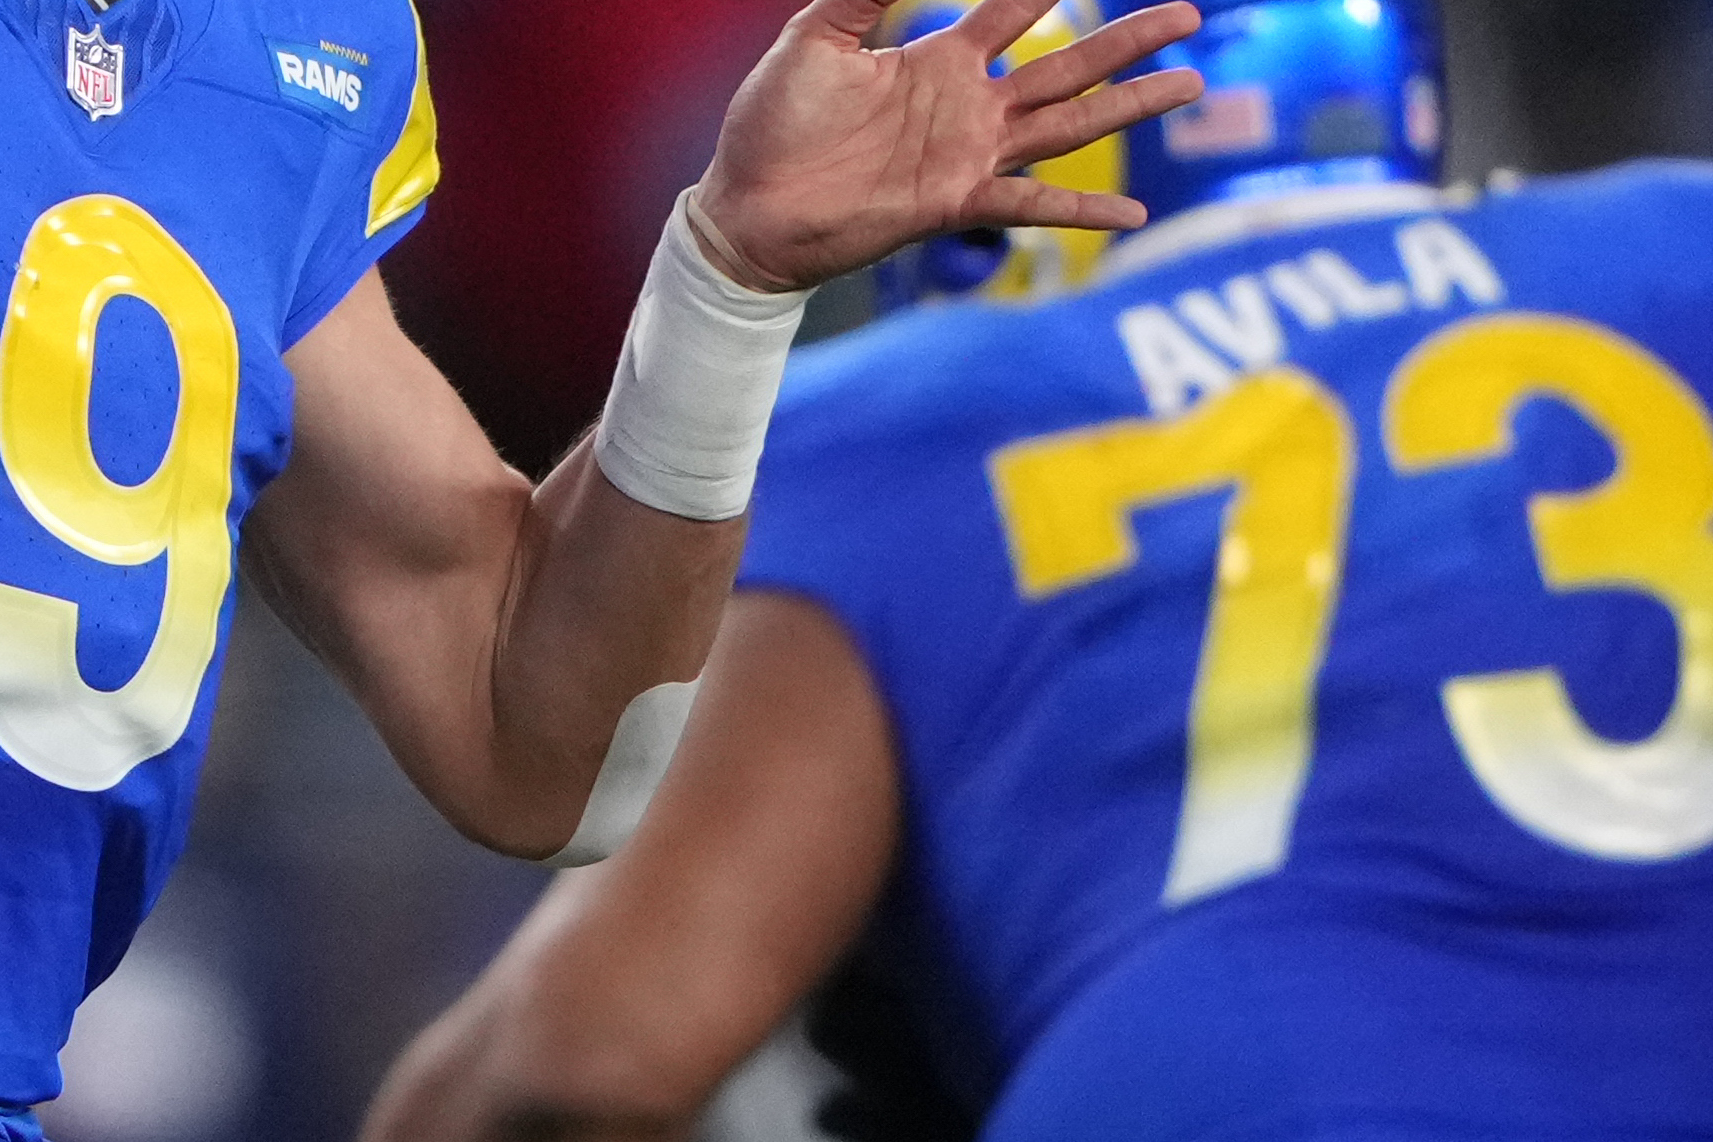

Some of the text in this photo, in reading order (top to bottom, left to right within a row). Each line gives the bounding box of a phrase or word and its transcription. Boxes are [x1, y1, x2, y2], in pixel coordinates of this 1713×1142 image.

[78, 64, 113, 103] NFL
[276, 51, 362, 112] RAMS
[1115, 217, 1508, 418] AVILA
[986, 310, 1713, 911] 73
